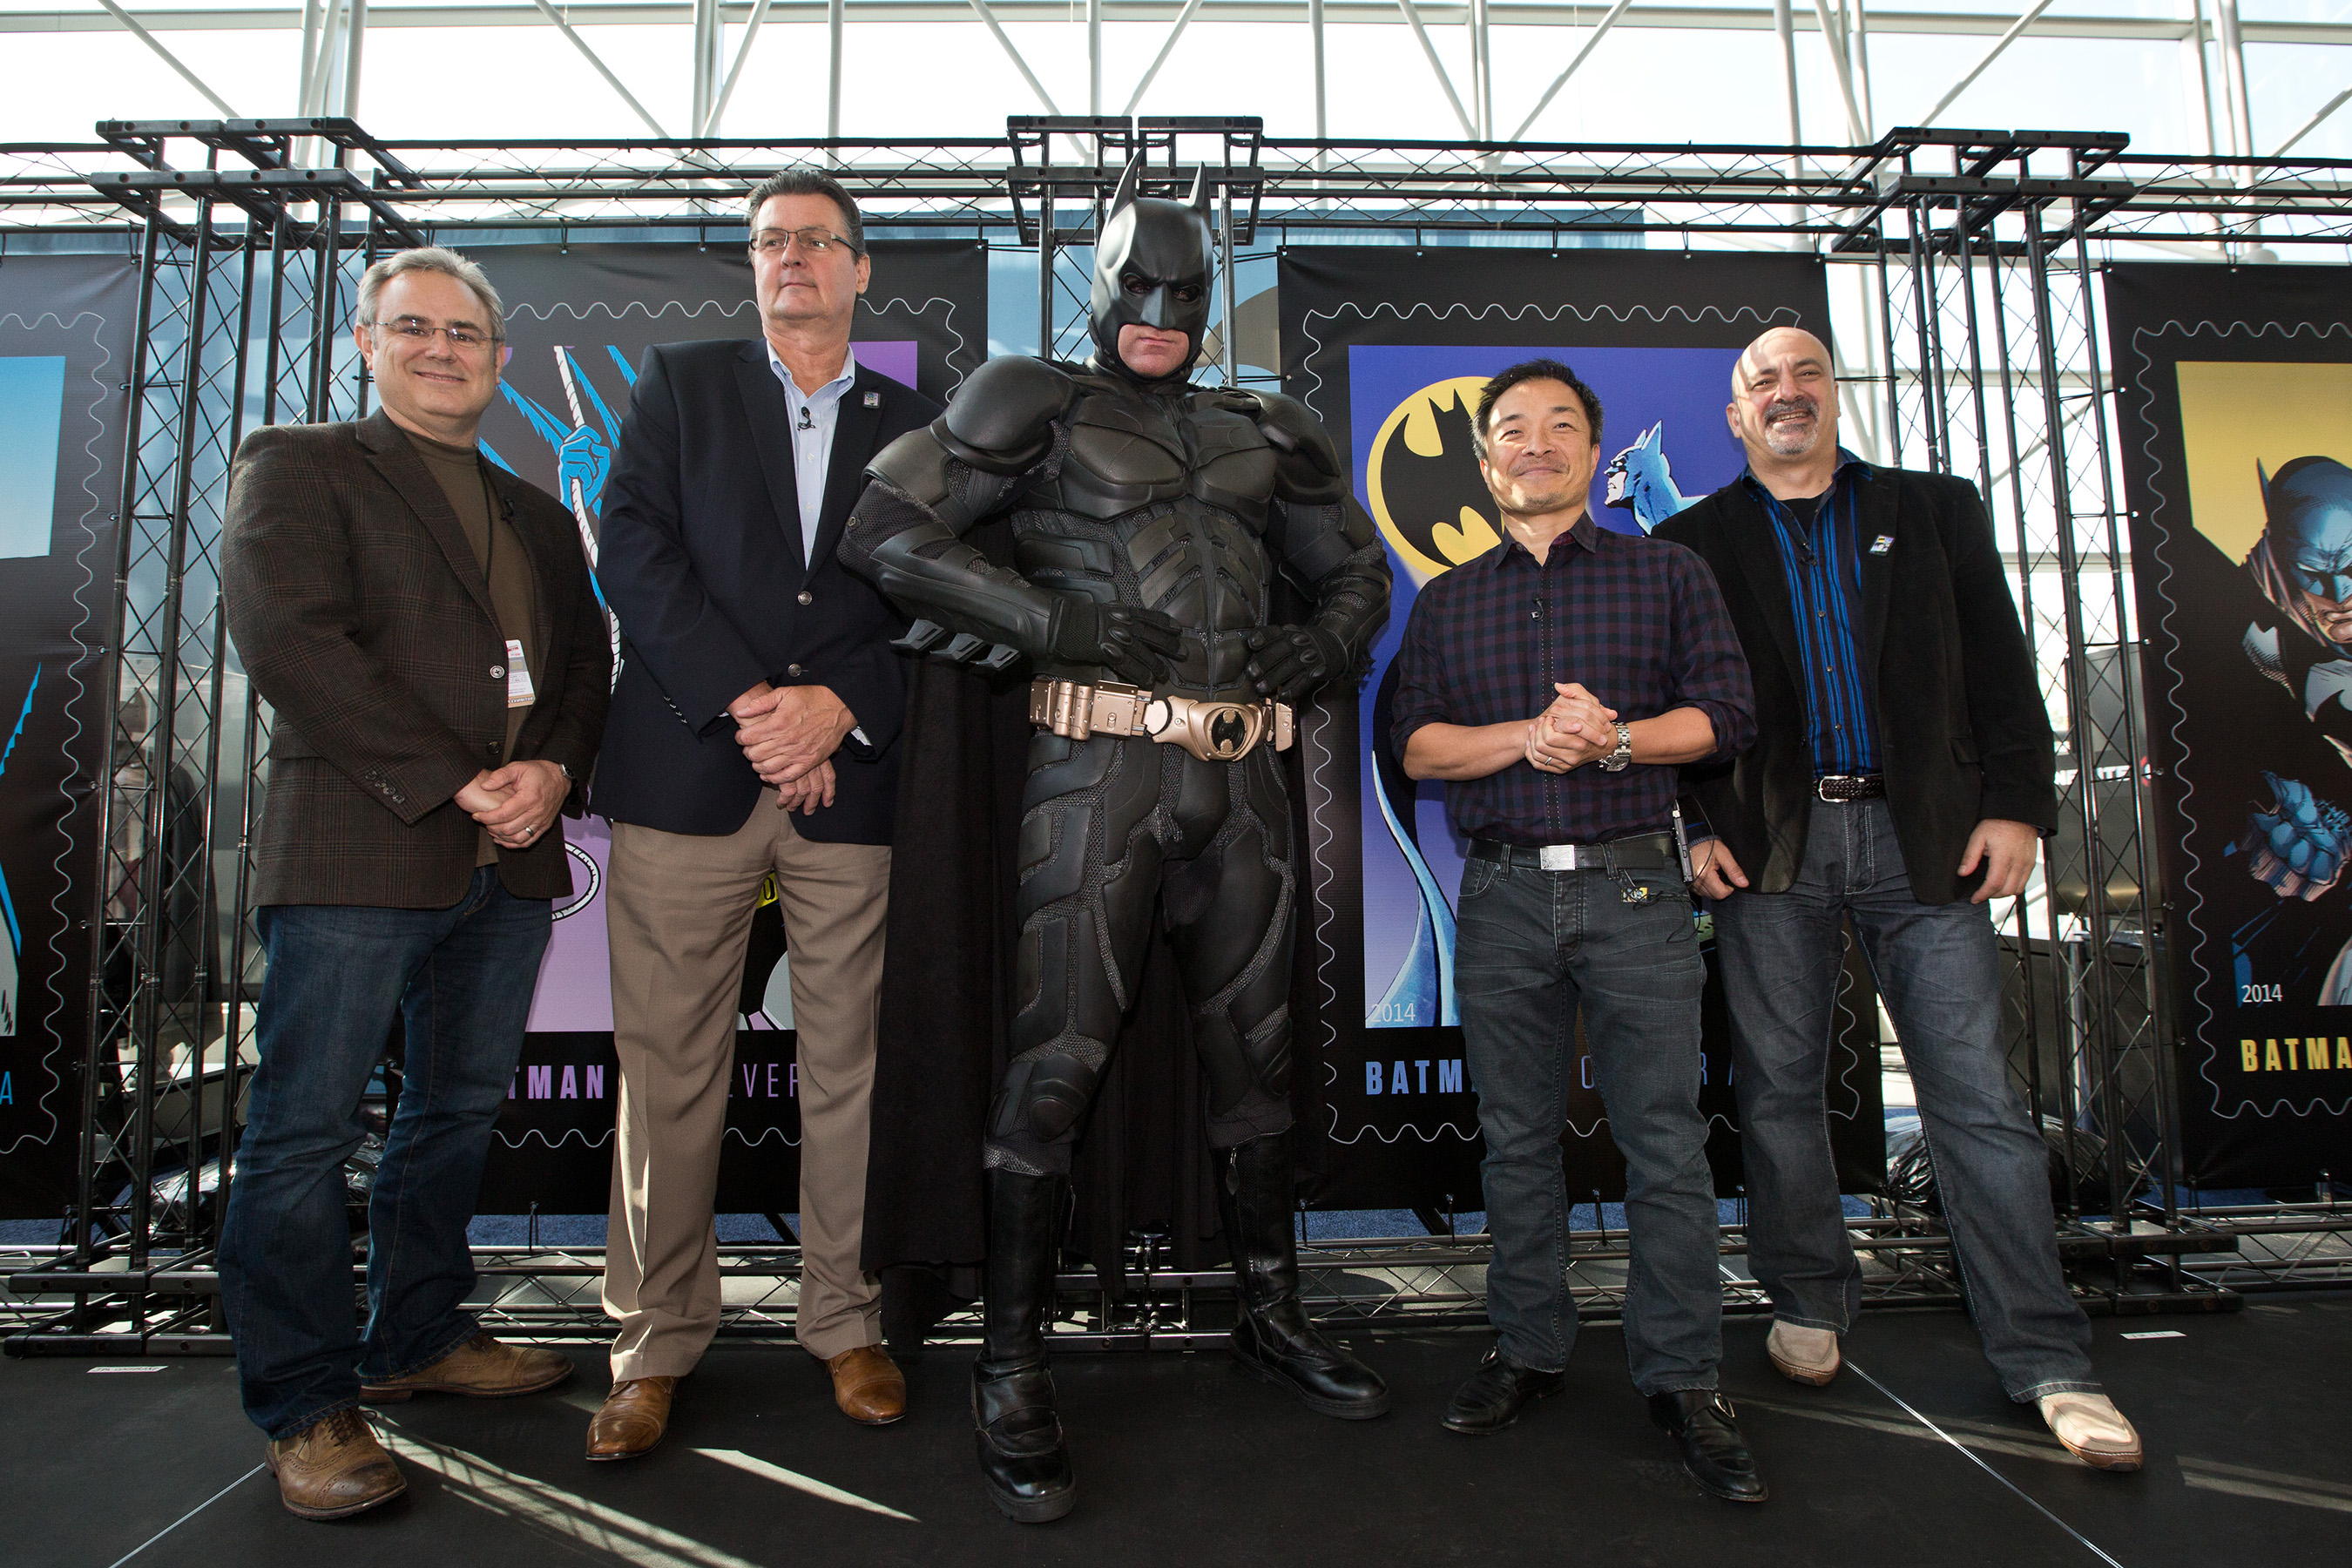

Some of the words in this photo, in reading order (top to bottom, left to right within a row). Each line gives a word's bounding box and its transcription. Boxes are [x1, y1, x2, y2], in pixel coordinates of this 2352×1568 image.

[2241, 984, 2283, 1003] 2014
[1370, 1003, 1416, 1023] 2014
[2240, 1037, 2352, 1072] BATMA
[1365, 1058, 1477, 1095] BATM
